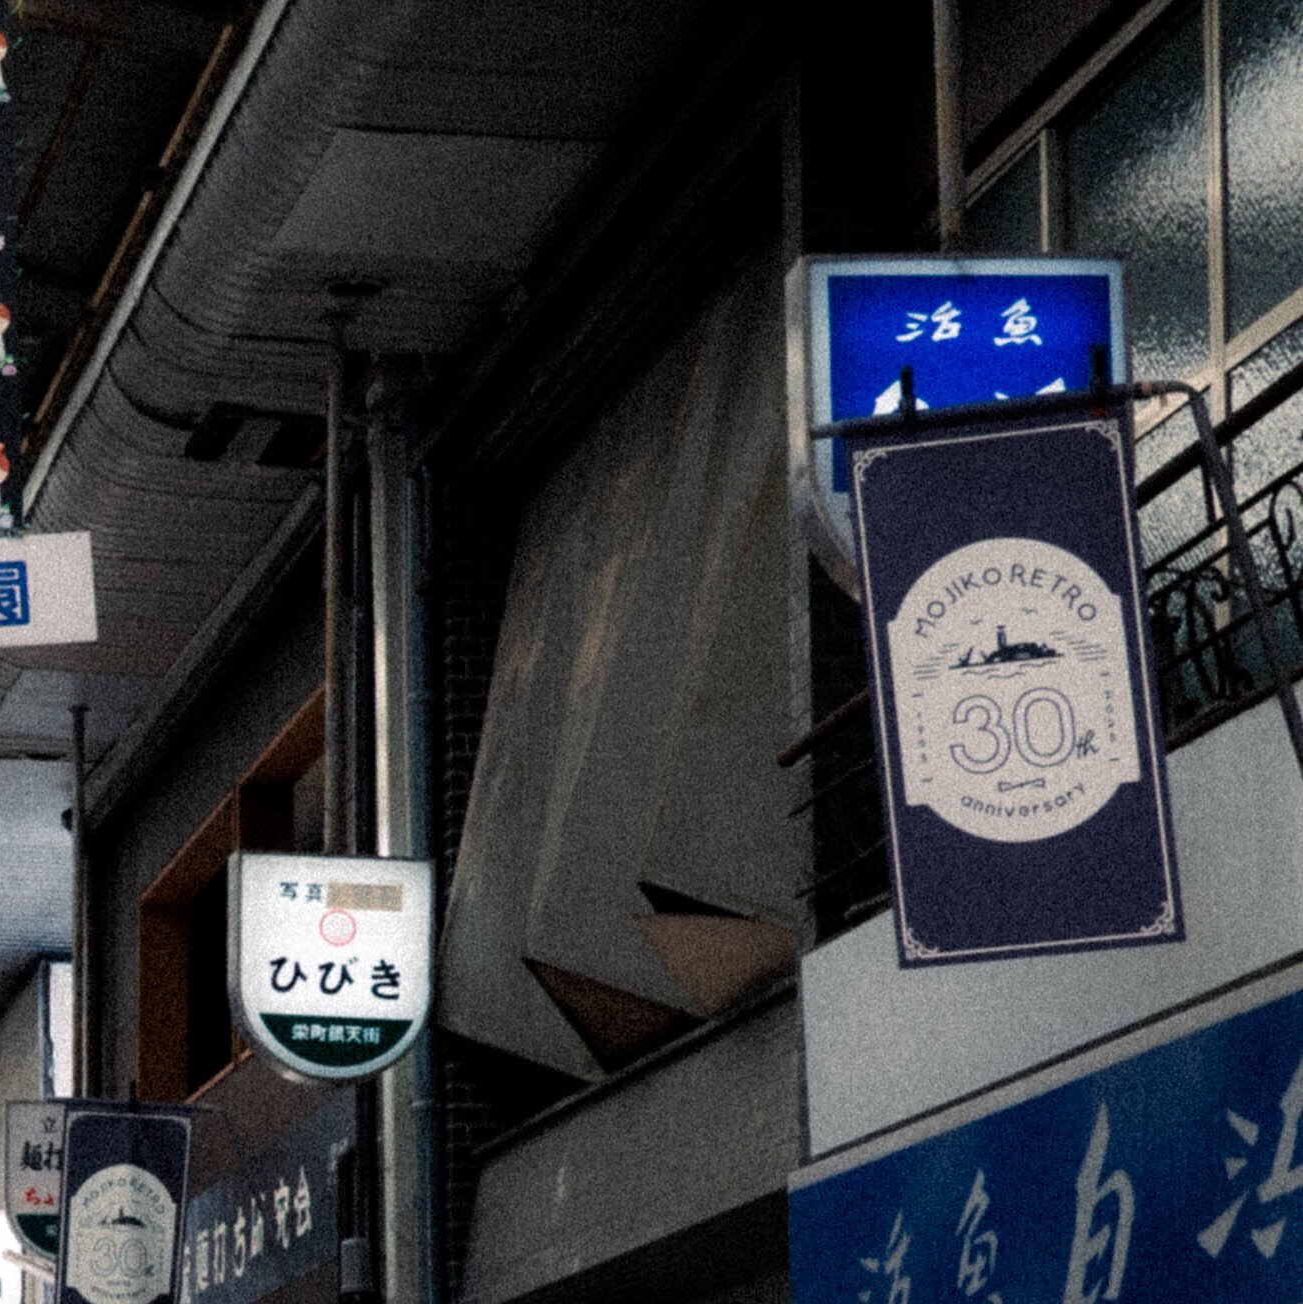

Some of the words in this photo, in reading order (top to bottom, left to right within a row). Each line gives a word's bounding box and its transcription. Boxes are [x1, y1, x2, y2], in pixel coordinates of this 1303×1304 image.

[914, 566, 1002, 638] MOJIKO
[1010, 563, 1099, 623] RETRO
[960, 782, 1086, 817] anniversary
[269, 956, 401, 1000] ひびき
